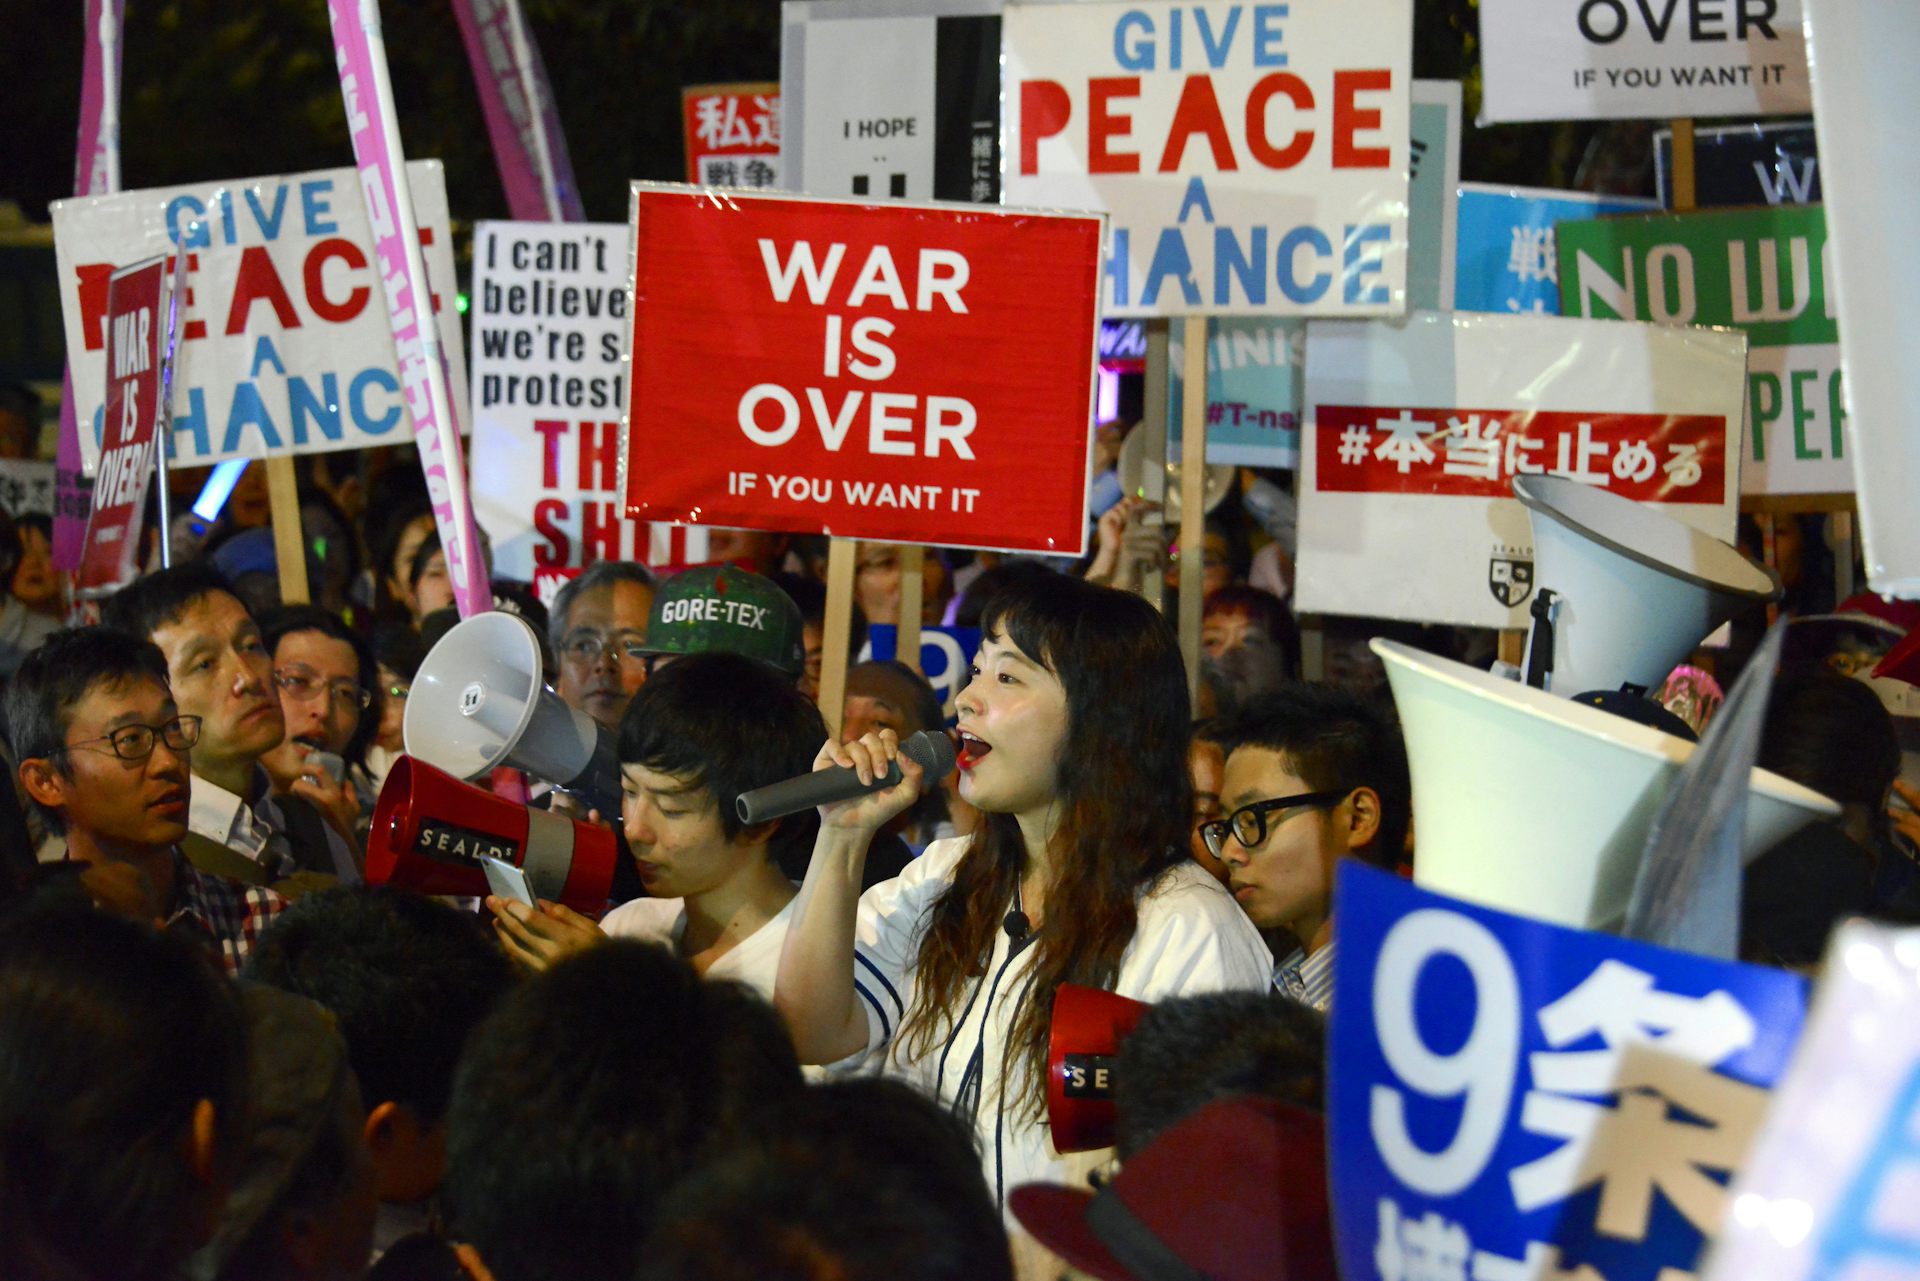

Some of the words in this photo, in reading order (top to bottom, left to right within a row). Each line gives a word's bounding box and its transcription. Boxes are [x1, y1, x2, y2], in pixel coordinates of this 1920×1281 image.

[1113, 4, 1290, 72] GIVE
[1577, 0, 1779, 45] OVER
[1574, 70, 1598, 89] IF
[1605, 67, 1661, 88] YOU
[1668, 65, 1754, 87] WANT
[1762, 64, 1787, 85] IT
[844, 121, 850, 138] I
[859, 118, 917, 138] HOPE
[1020, 69, 1392, 177] PEACE
[165, 179, 339, 250] GIVE
[1177, 176, 1215, 224] A
[487, 233, 496, 269] I
[512, 235, 607, 273] can't
[757, 238, 970, 314] WAR
[1104, 224, 1391, 306] HANCE
[1576, 243, 1696, 324] NO
[76, 227, 441, 352] PEAC
[483, 278, 626, 319] believe
[114, 306, 151, 380] WAR
[251, 335, 287, 378] A
[482, 324, 584, 362] we're
[824, 314, 897, 381] IS
[119, 378, 139, 443] IS
[738, 383, 977, 460] OVER
[1336, 409, 1704, 489] #本当に止める
[728, 471, 757, 496] IF
[766, 474, 832, 503] YOU
[842, 480, 942, 511] WANT
[951, 488, 981, 513] IT
[661, 597, 766, 631] GORE-TEX
